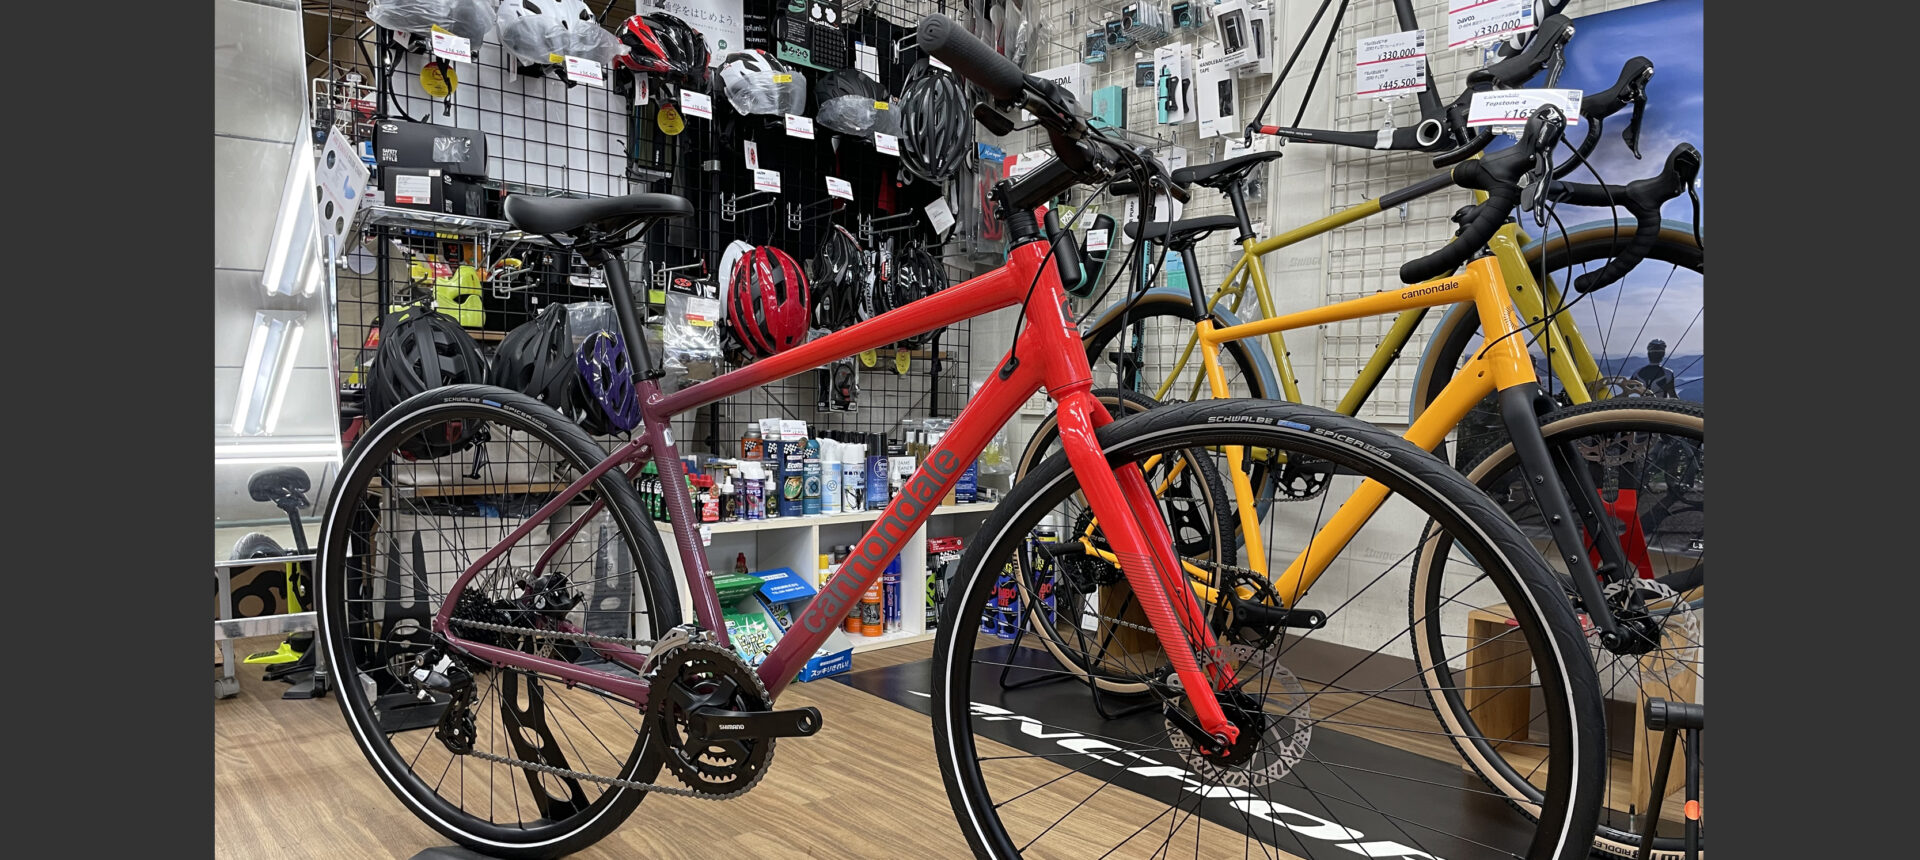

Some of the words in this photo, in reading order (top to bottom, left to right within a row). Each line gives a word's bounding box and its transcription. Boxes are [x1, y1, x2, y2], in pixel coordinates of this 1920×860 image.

[1401, 281, 1459, 300] cannondale
[1207, 415, 1274, 425] SCHWALBE
[1313, 428, 1365, 447] SPICER
[803, 449, 960, 633] cannondale
